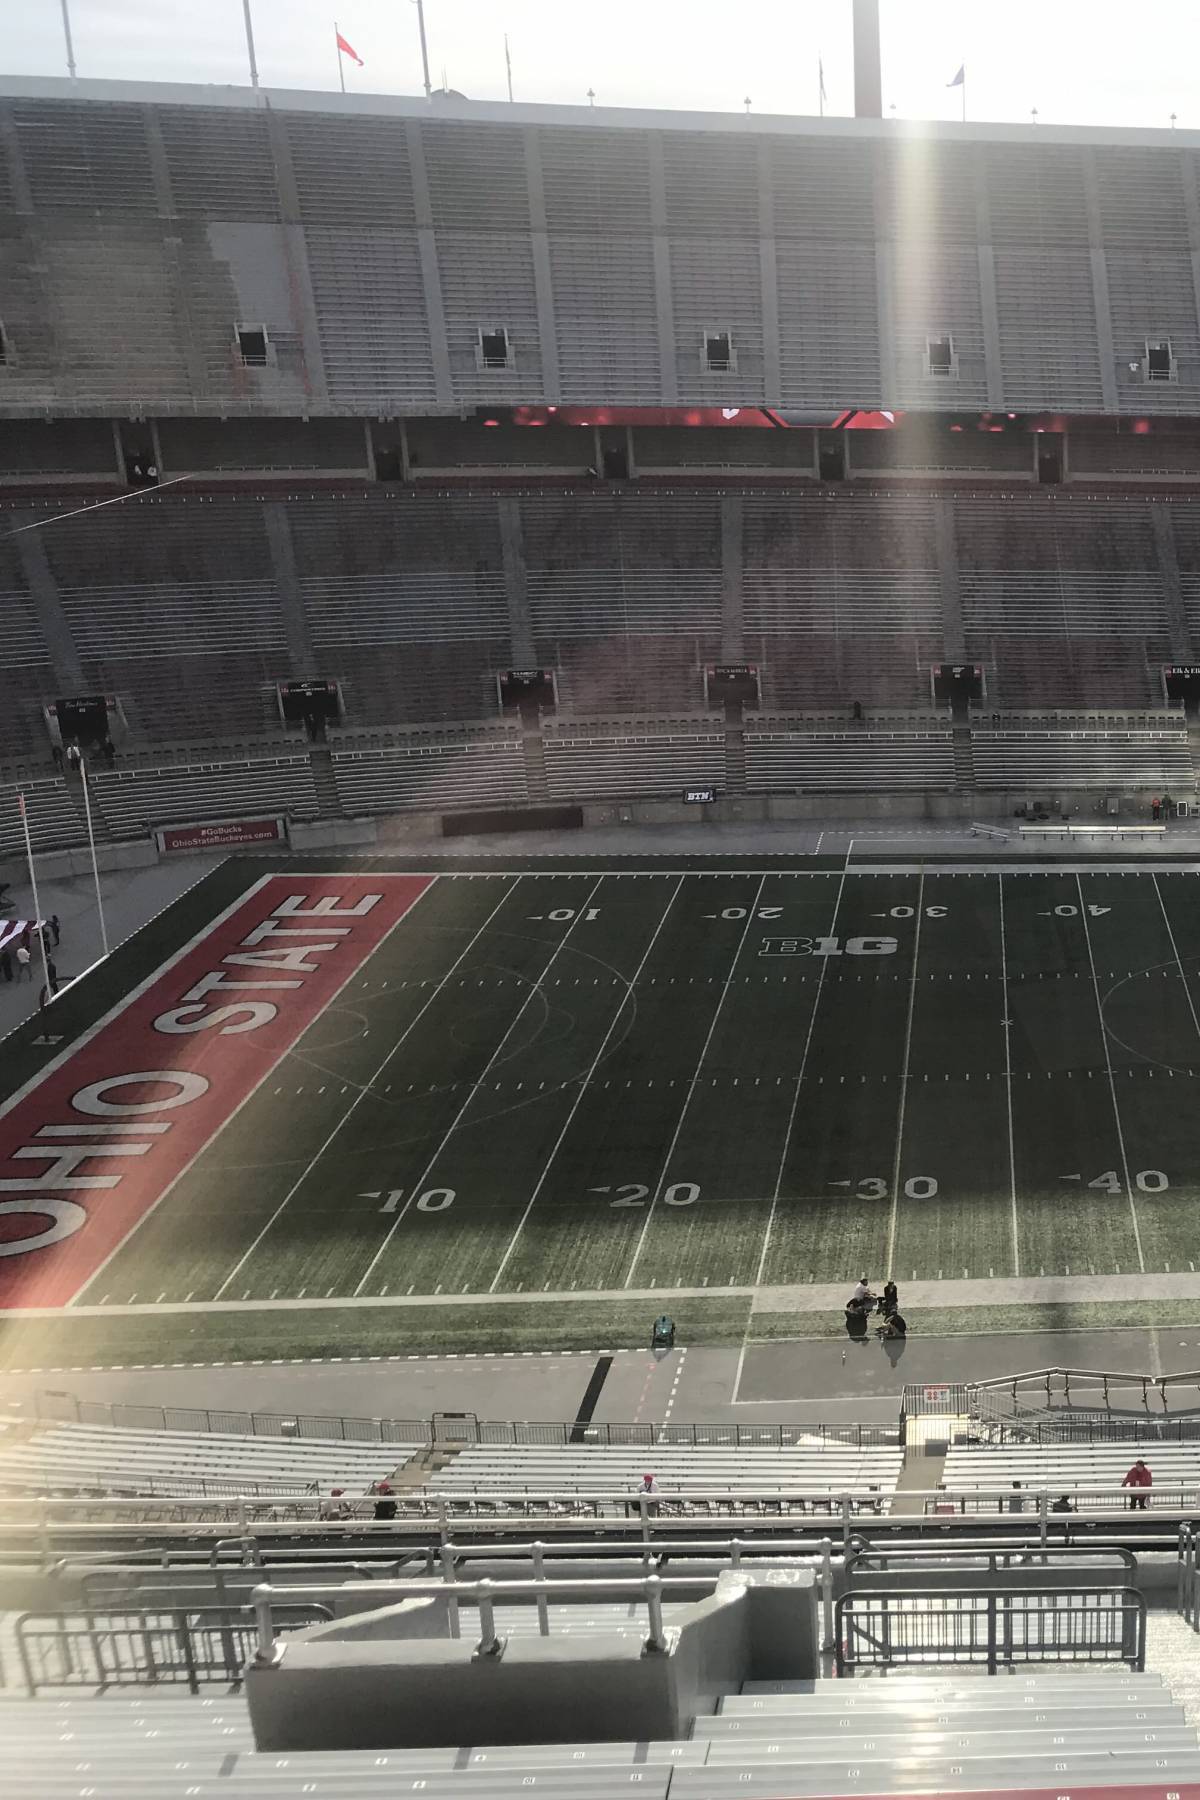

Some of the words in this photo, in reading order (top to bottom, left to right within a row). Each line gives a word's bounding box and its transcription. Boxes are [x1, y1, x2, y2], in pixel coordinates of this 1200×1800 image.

[687, 792, 709, 801] BTN
[201, 825, 242, 836] #GoBucks
[172, 831, 272, 848] OhioStateBuckeyes.com
[546, 907, 601, 920] 10
[722, 906, 783, 919] 20
[890, 906, 949, 918] 30
[1053, 905, 1112, 918] 40
[0, 1070, 209, 1256] OHIO
[154, 894, 383, 1035] STATE
[856, 1176, 938, 1200] 30
[1088, 1170, 1169, 1194] 40
[380, 1188, 456, 1213] 10
[609, 1182, 702, 1208] 20
